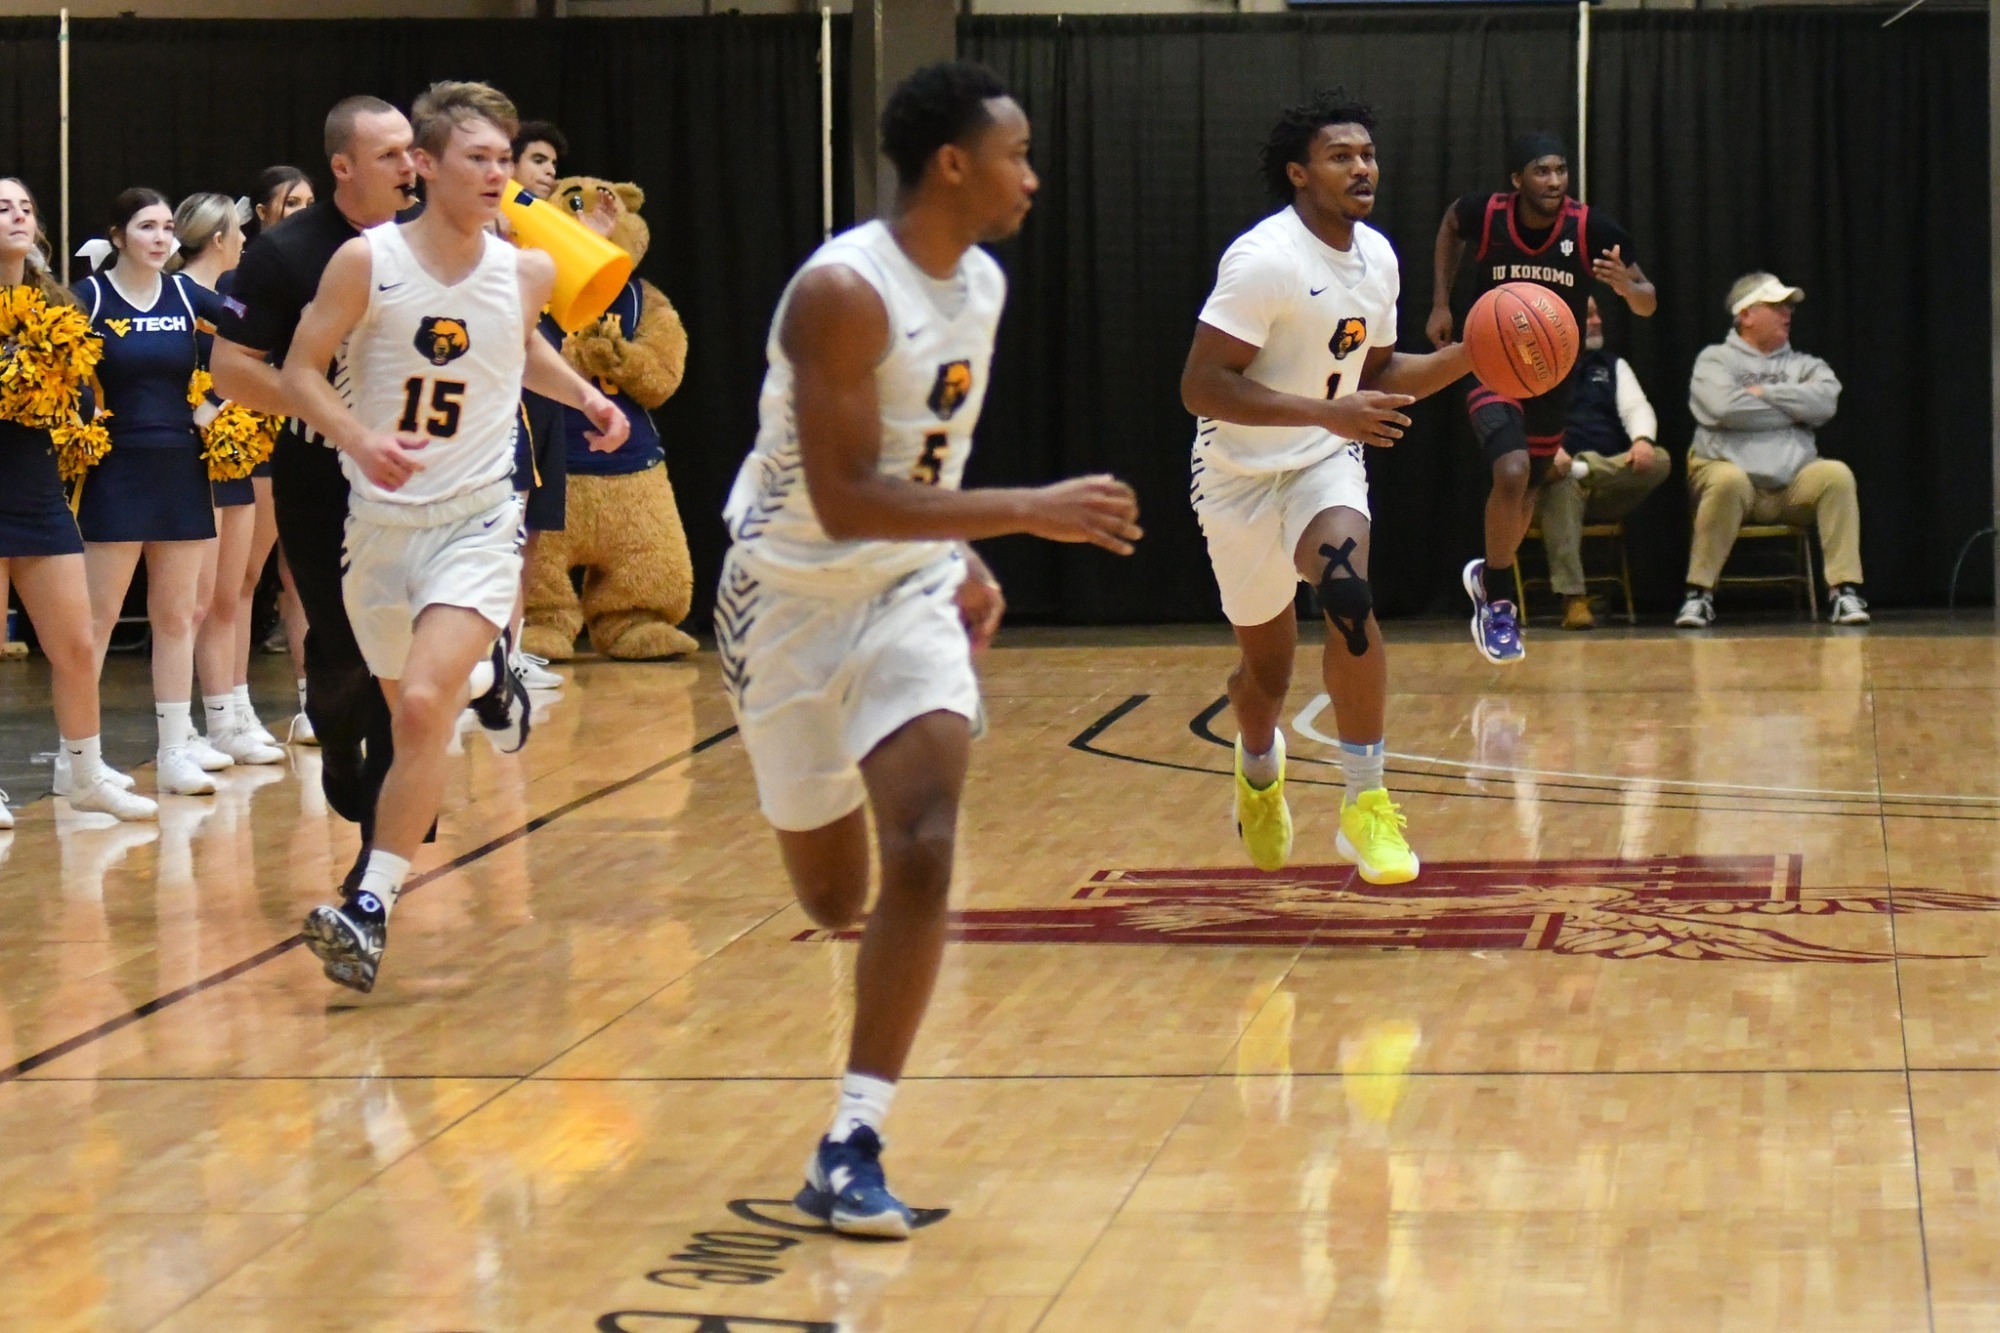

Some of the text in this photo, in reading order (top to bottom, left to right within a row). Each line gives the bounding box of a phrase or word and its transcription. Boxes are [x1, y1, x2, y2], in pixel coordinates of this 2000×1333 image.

[1493, 264, 1574, 287] IU KOKOMO
[132, 316, 187, 332] TECH
[397, 374, 467, 438] 15
[910, 428, 949, 485] 5
